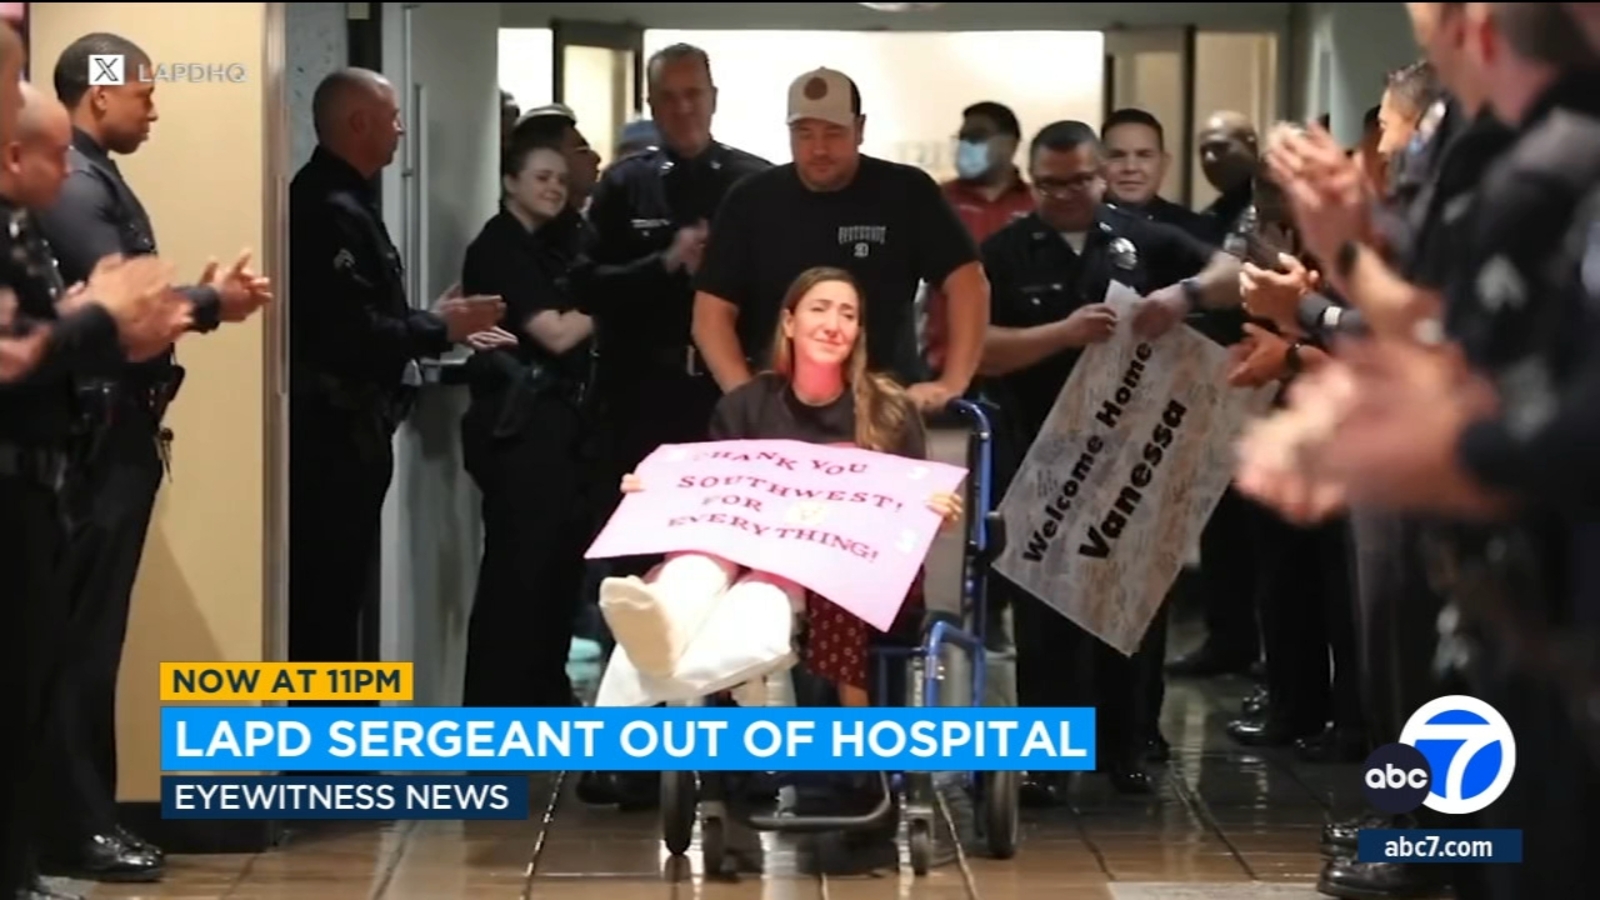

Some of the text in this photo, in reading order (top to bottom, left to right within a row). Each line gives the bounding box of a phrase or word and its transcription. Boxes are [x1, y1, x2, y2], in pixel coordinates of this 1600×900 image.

[811, 459, 868, 475] YOU
[1022, 342, 1152, 563] Welcome Home
[677, 475, 903, 512] SOUTHWEST!
[1079, 399, 1187, 559] Vanessa
[668, 513, 879, 563] EVERYTHING!
